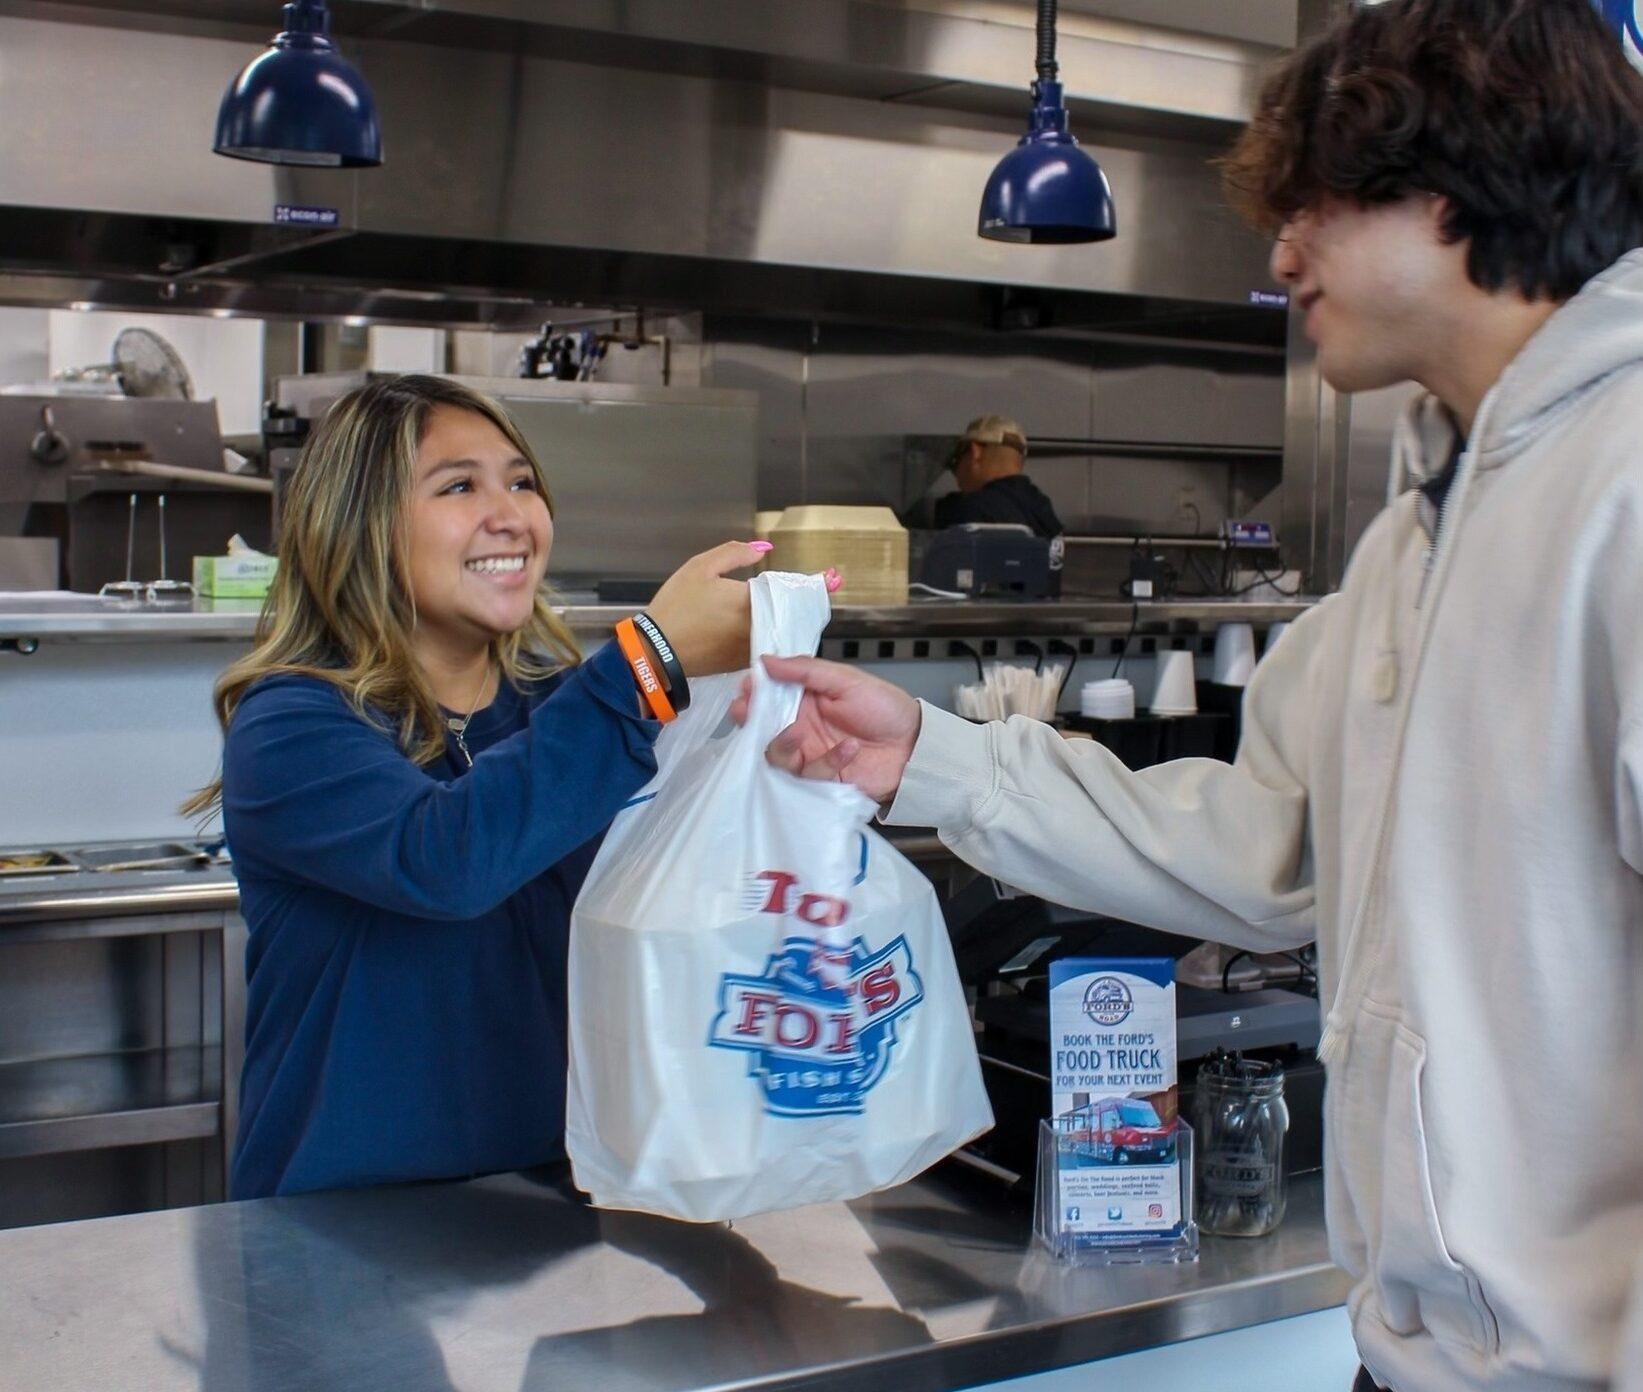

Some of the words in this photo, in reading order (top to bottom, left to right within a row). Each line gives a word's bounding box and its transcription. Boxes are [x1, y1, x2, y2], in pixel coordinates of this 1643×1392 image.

[634, 657, 658, 693] TIGERS
[1063, 1034, 1092, 1046] BOOK
[1095, 1034, 1115, 1045] THE
[1118, 1033, 1154, 1045] FORD'S
[1056, 1051, 1100, 1070] FOOD
[1107, 1050, 1161, 1070] TRUCK
[1056, 1075, 1075, 1086] FOR
[1078, 1075, 1105, 1085] YOUR
[1107, 1074, 1132, 1085] NEXT
[1134, 1074, 1162, 1085] EVENT
